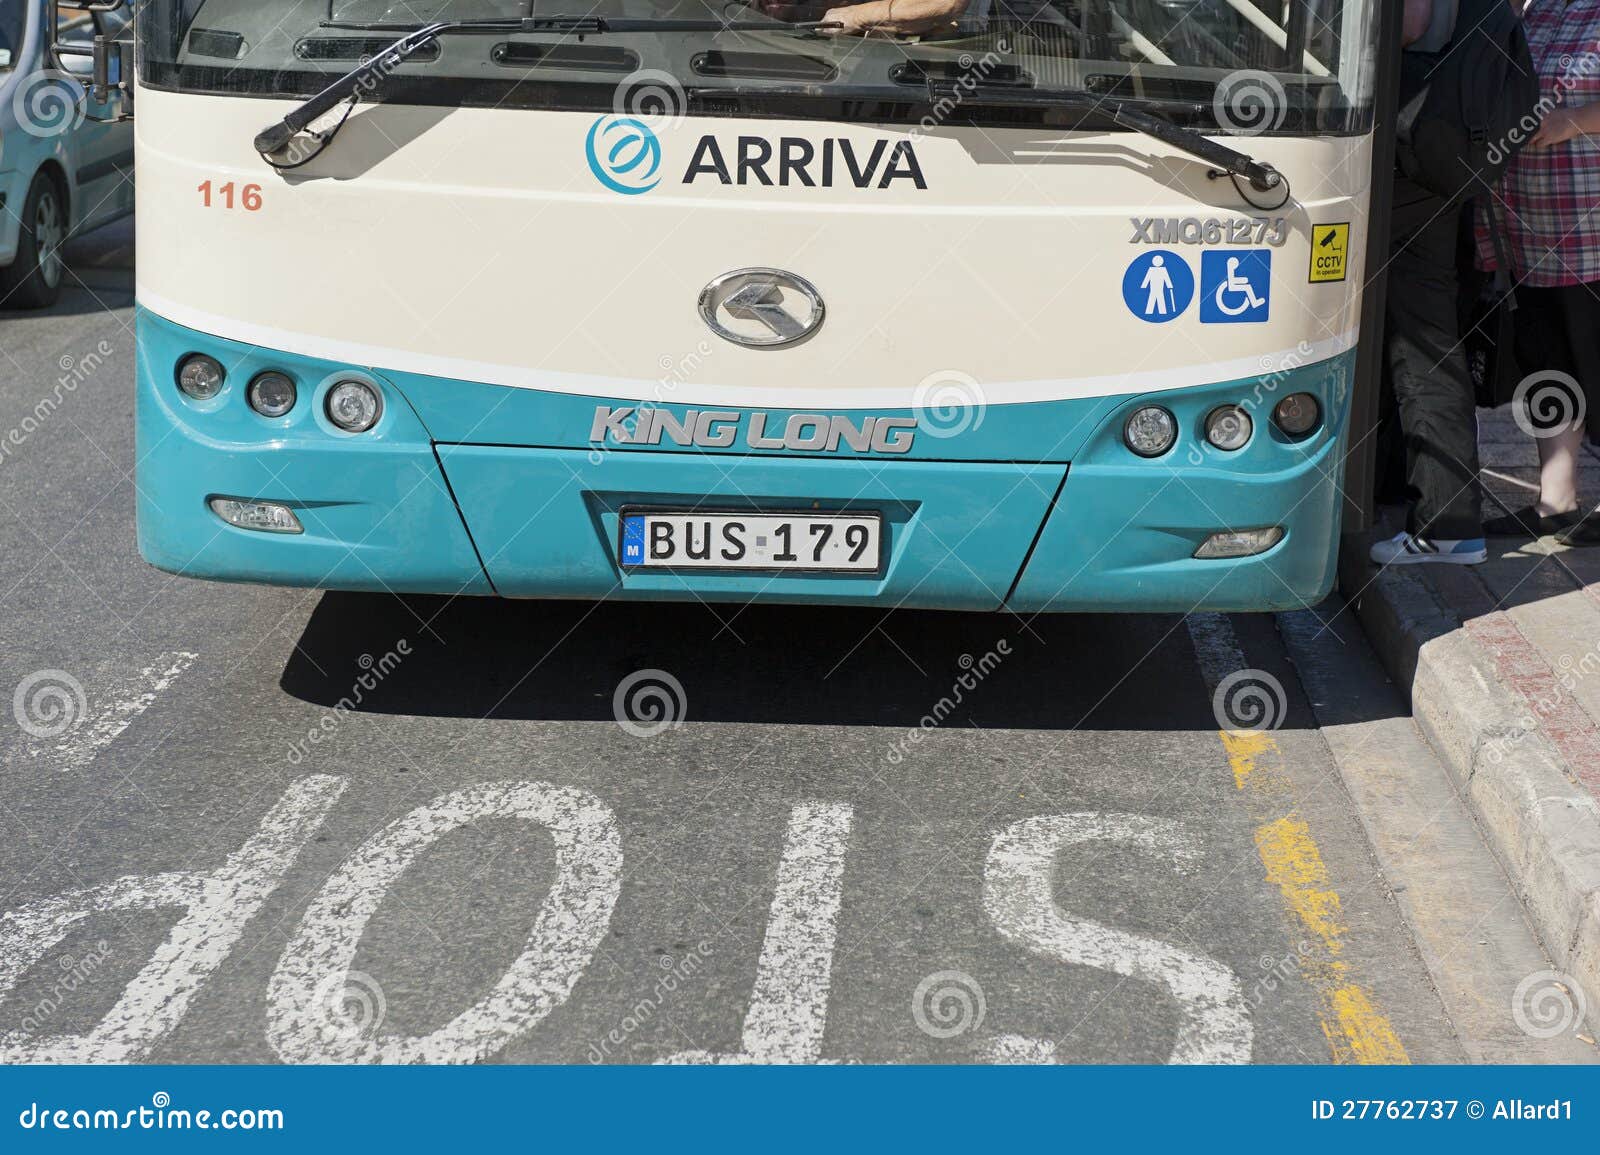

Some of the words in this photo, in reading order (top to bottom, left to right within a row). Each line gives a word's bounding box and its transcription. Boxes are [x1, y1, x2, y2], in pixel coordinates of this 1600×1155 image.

[682, 135, 928, 190] ARRIVA
[198, 180, 262, 211] 116
[1317, 256, 1342, 268] CCTV
[590, 406, 740, 447] KING
[747, 412, 918, 453] LONG
[627, 545, 638, 556] M
[650, 521, 746, 560] BUS
[773, 523, 869, 562] 179
